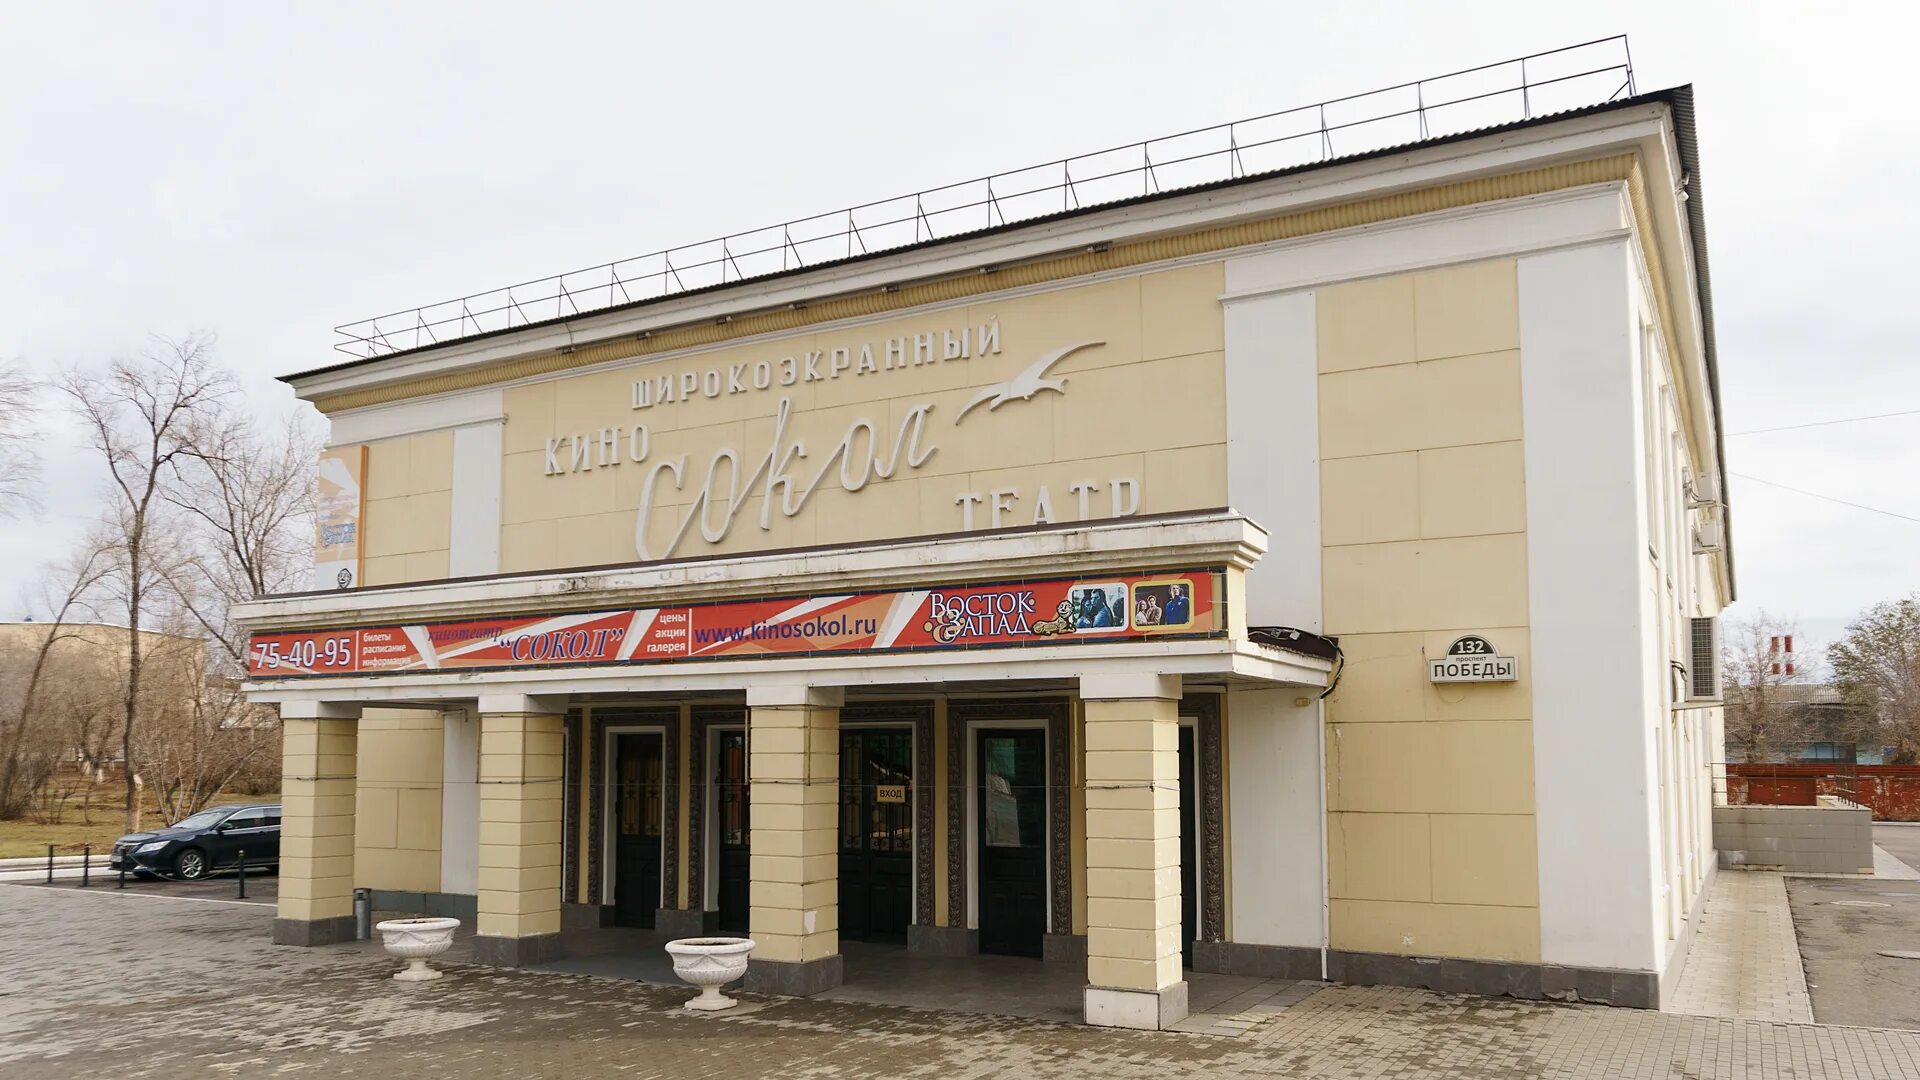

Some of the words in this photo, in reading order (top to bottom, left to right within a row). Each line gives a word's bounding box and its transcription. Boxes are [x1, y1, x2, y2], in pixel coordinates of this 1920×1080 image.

[630, 315, 1002, 409] ШИРОКОЭКРАННЫЙ
[544, 424, 651, 476] КИНО
[660, 613, 686, 624] цены
[428, 625, 503, 642] кинотеатр
[655, 628, 686, 639] акции
[694, 614, 877, 644] www.kinosokol.ru
[363, 632, 392, 642] билеты
[255, 638, 351, 669] 75-40-95
[362, 644, 406, 655] расписание
[647, 642, 686, 654] галерея
[1457, 640, 1485, 654] 132
[362, 656, 412, 667] информация
[1434, 662, 1511, 678] ПОБЕДЫ
[880, 789, 902, 799] ВХОД
